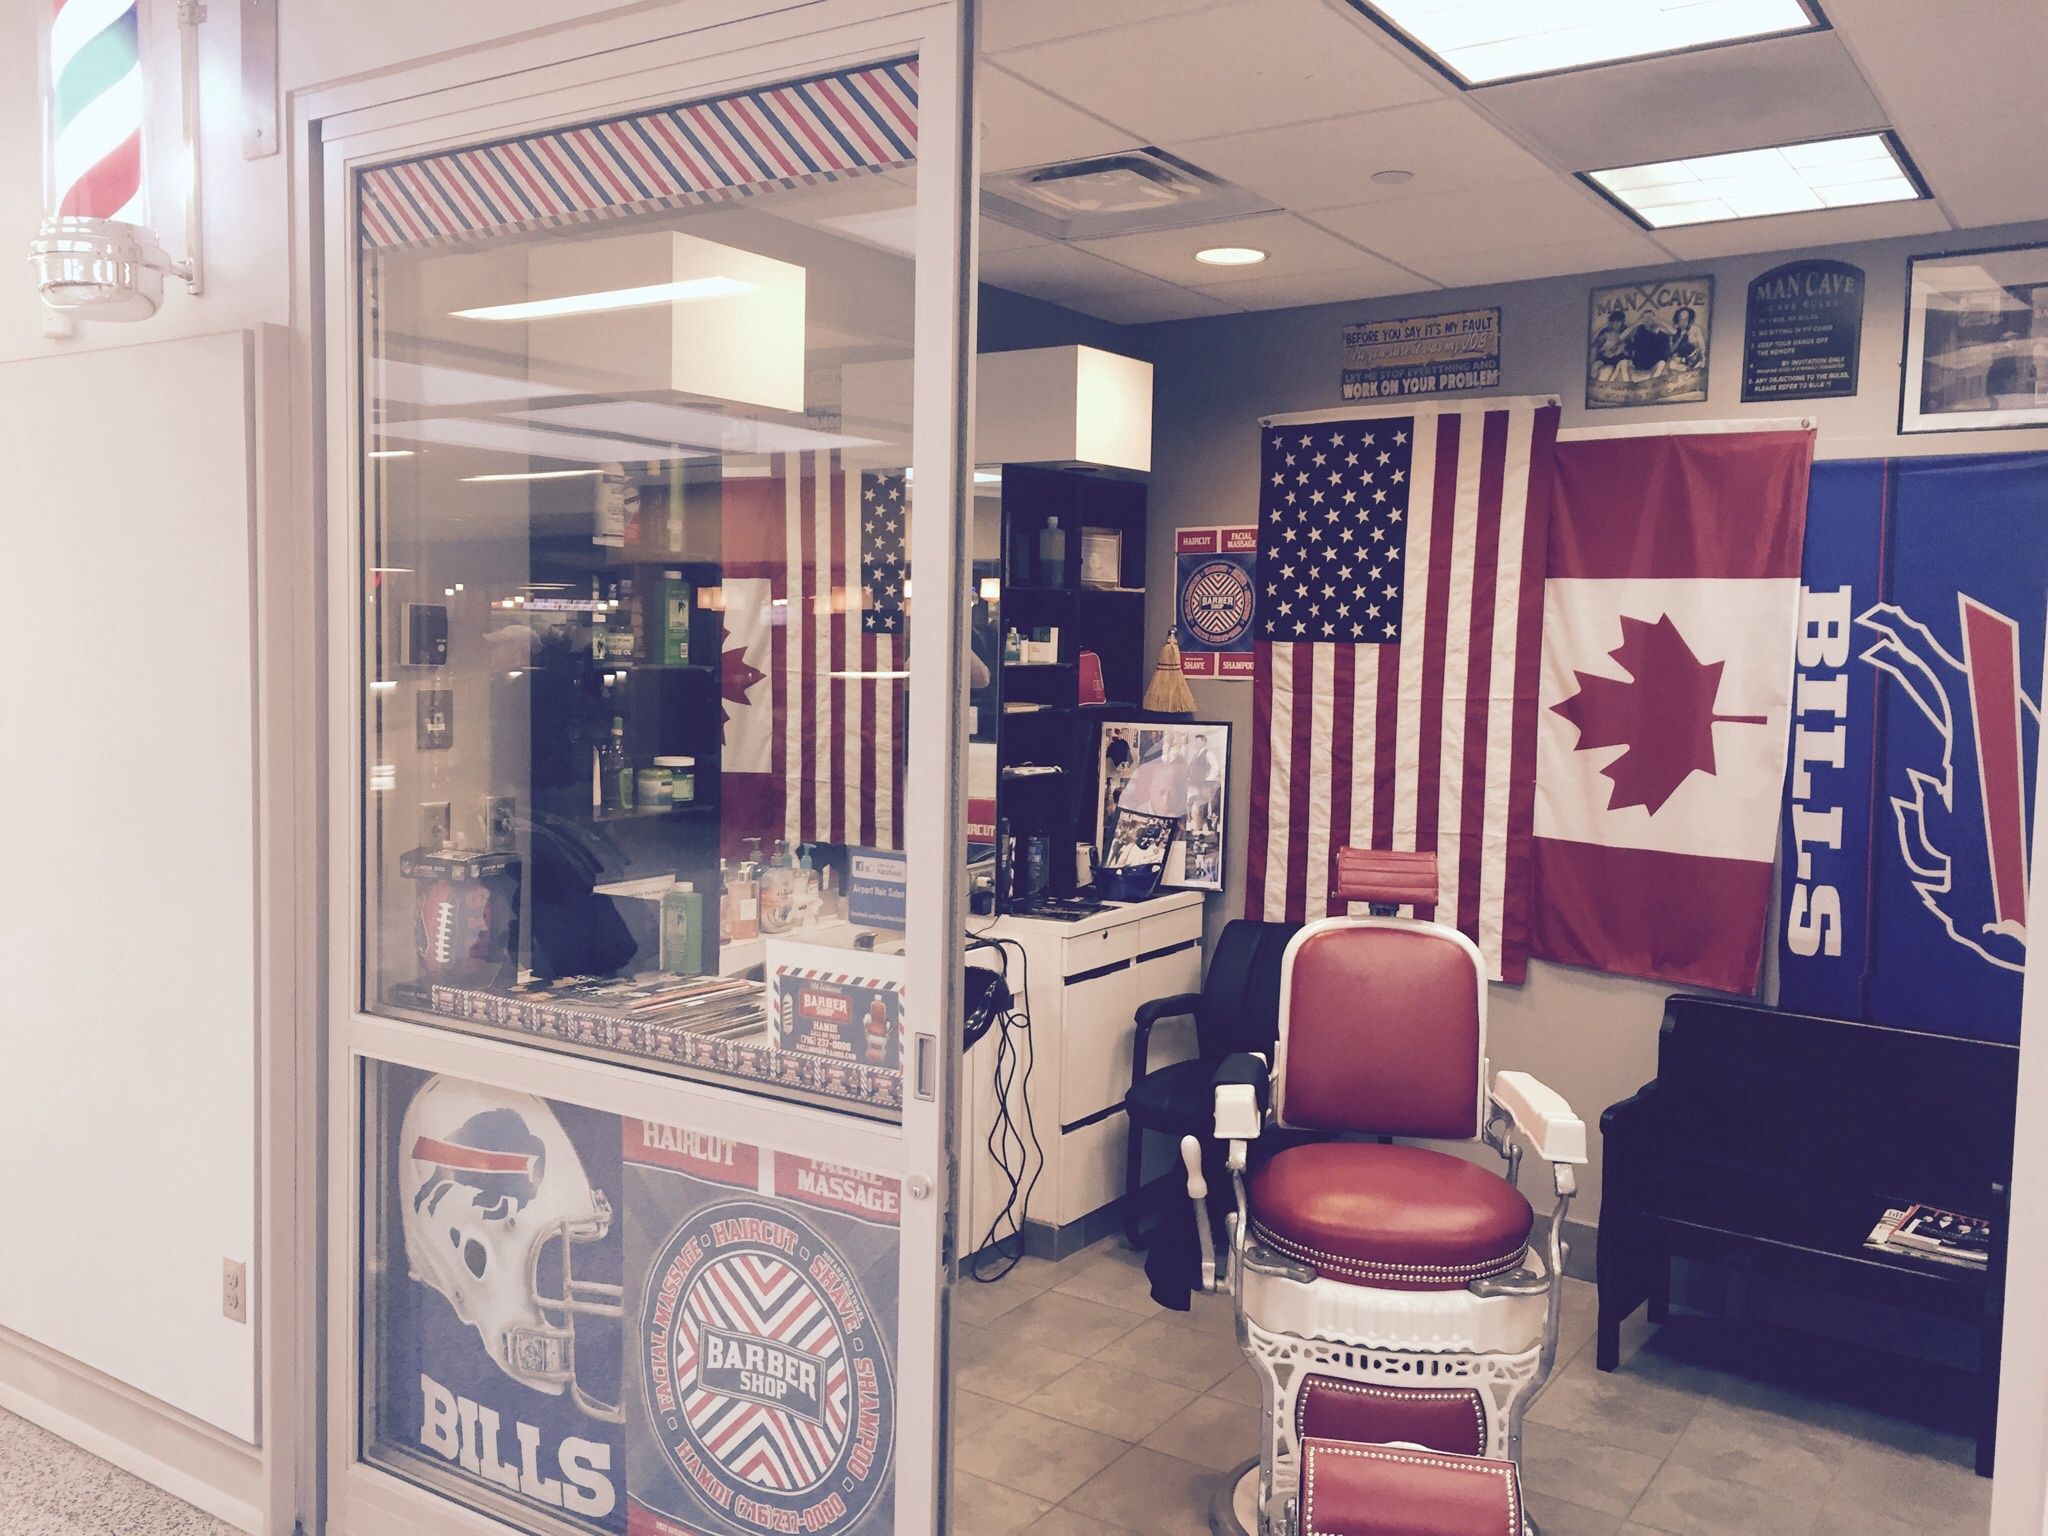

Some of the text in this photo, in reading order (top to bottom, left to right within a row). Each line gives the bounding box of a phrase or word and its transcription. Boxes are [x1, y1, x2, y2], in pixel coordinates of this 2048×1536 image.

[1657, 289, 1706, 307] CAVE
[1757, 271, 1855, 300] MAN CAVE
[1346, 317, 1493, 345] BEFORE YOU SAY IT'S MY FAULT
[1472, 360, 1496, 370] AND
[1343, 369, 1498, 399] WORK ON YOUR PROBLEM
[1183, 537, 1212, 545] HAIRCUT
[1227, 539, 1257, 548] MASSAGE
[1231, 532, 1253, 540] FACIAL
[1202, 596, 1234, 605] BARBER
[1184, 661, 1205, 669] SHAVE
[1787, 584, 1853, 957] BILLS
[853, 883, 874, 895] Airport
[804, 994, 848, 1014] BARBER
[642, 1119, 736, 1166] HAIRCUT
[798, 1168, 899, 1214] MASSAGE
[710, 1217, 799, 1255] HAIRCUT
[808, 1254, 861, 1335] SHAVE
[651, 1236, 704, 1414] FACIAL MASSAGE
[707, 1335, 817, 1402] BARBER
[740, 1370, 788, 1400] SHOP
[846, 1357, 880, 1482] SHAMPOO
[420, 1373, 616, 1518] BILLS
[675, 1437, 734, 1509] HAMDI
